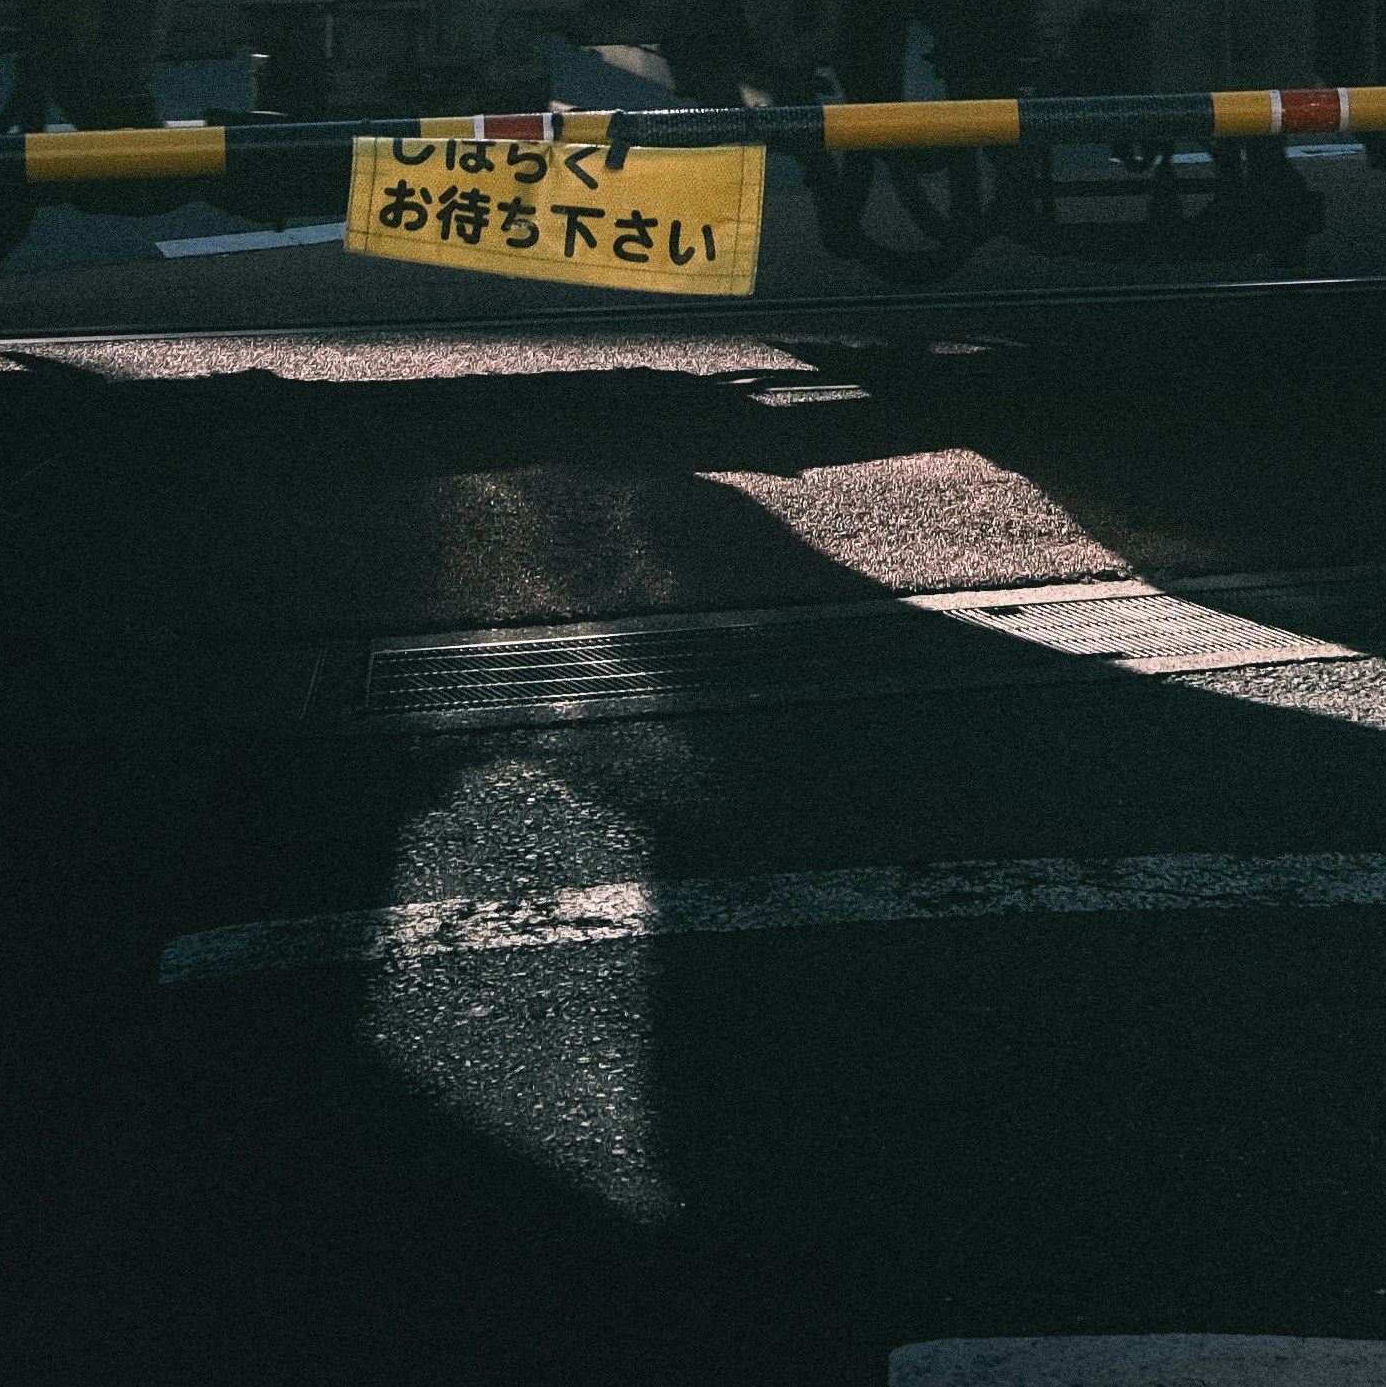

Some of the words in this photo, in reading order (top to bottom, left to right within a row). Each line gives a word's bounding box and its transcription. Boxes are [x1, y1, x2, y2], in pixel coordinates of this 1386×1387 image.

[377, 178, 717, 267] お待ち下さい
